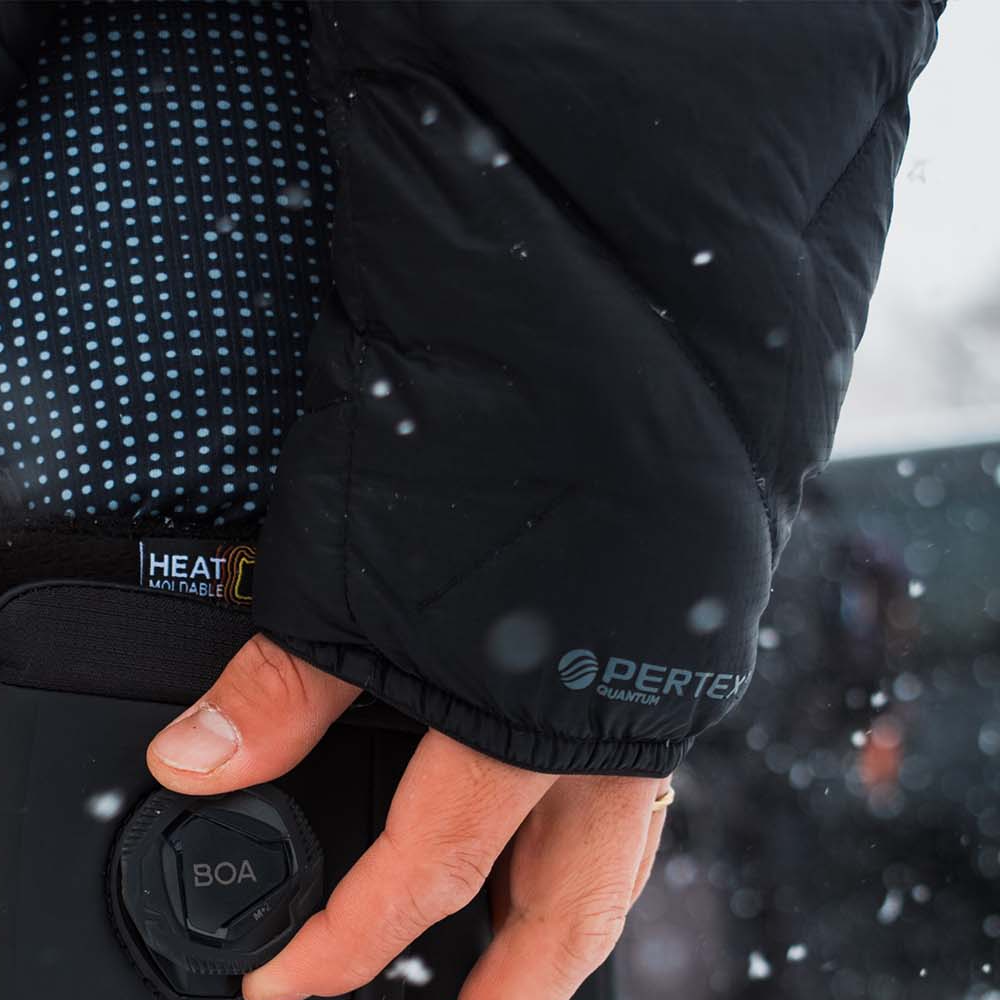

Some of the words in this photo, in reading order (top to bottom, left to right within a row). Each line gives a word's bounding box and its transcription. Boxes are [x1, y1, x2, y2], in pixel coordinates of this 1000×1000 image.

[149, 552, 227, 580] HEAT
[602, 656, 748, 700] PERTEX
[596, 684, 661, 706] QUANTUM
[193, 859, 257, 887] BOA
